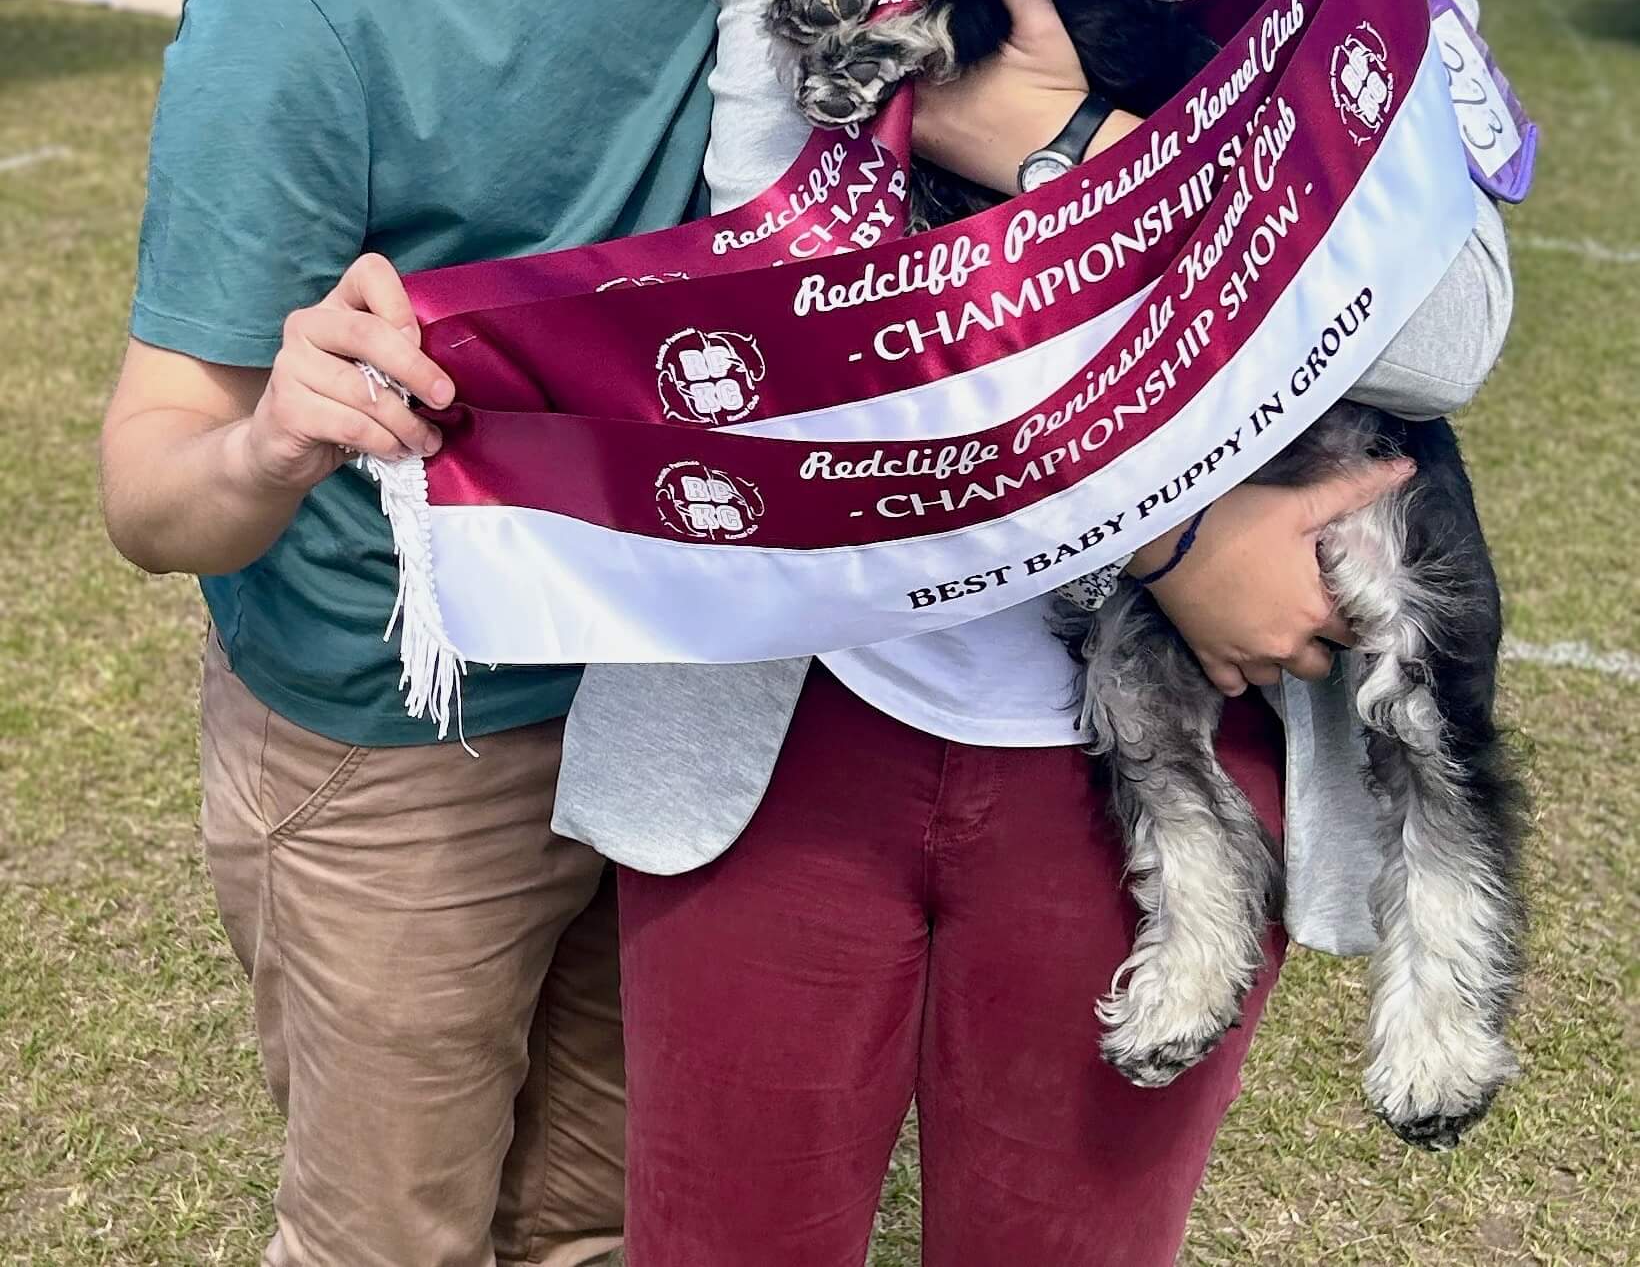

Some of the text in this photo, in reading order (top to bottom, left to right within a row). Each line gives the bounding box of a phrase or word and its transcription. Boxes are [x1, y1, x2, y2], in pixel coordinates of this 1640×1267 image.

[712, 143, 847, 255] Redcliffe
[793, 235, 991, 317] Redcliffe
[1003, 130, 1181, 264] Peninsula
[1186, 36, 1260, 144] Kennel
[800, 440, 999, 480] Redcliffe
[1012, 295, 1175, 455] Peninsula
[1177, 166, 1253, 300] Kennel
[1254, 97, 1296, 192] Club
[833, 199, 895, 256] BY
[874, 163, 1214, 361] CHAMPIONSHIP
[876, 308, 1214, 518] CHAMPIONSHIP
[1219, 185, 1299, 321] SHOW
[906, 287, 1374, 609] BEST BABY PUPPY IN GROUP
